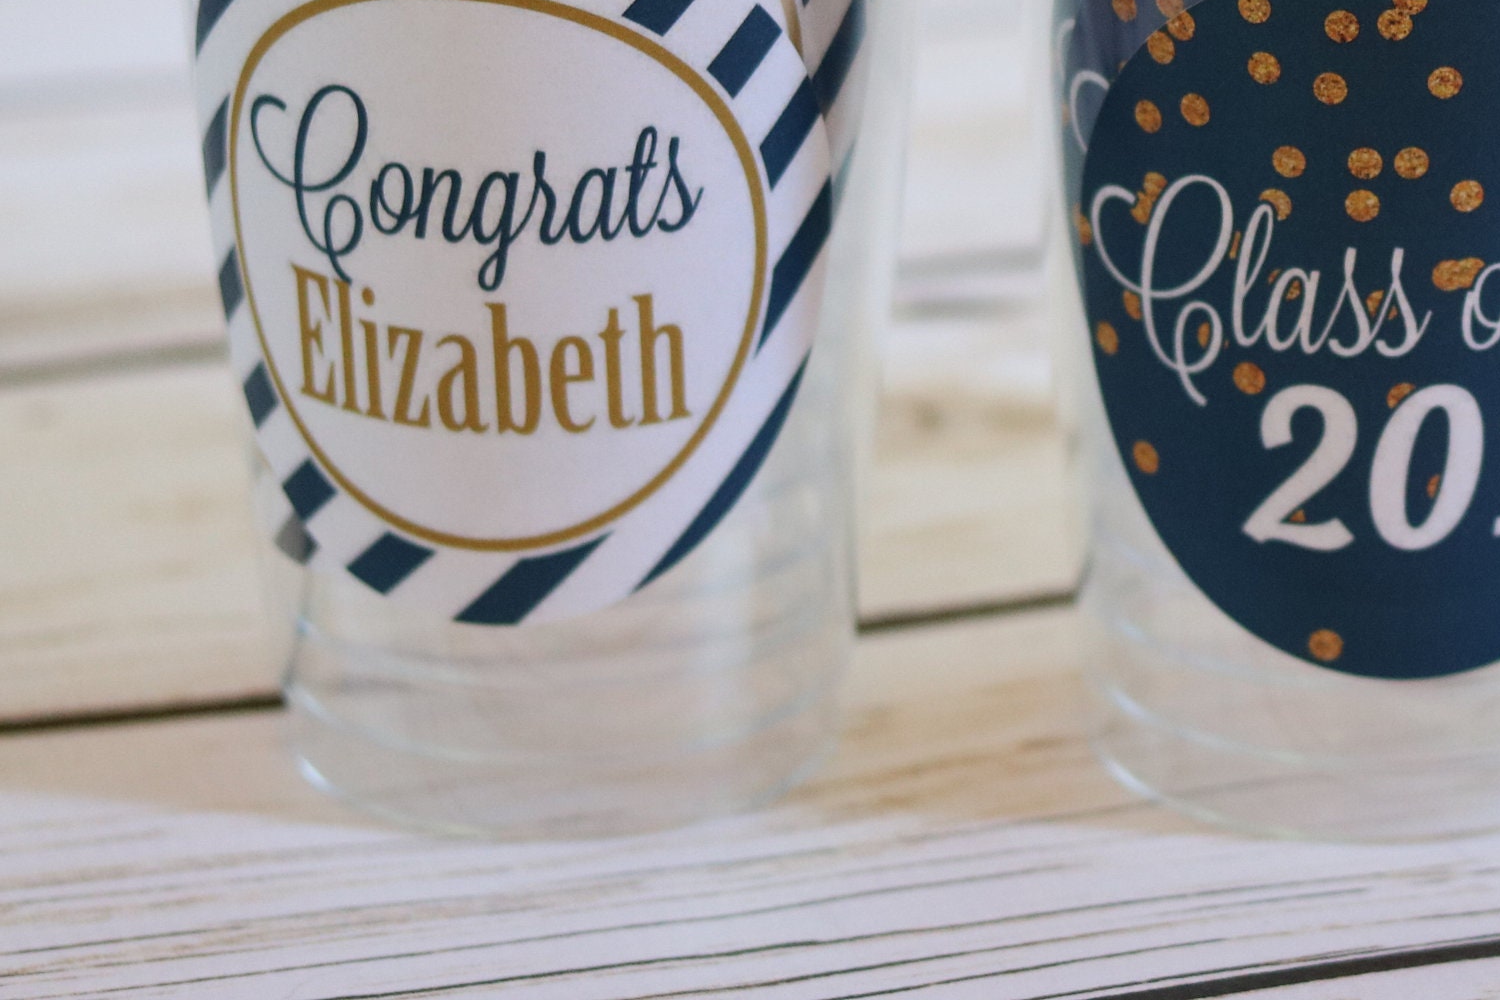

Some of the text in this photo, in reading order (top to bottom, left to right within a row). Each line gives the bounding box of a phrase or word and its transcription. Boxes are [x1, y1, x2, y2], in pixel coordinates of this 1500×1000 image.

[250, 84, 704, 292] Congrats
[1090, 174, 1433, 406] Class
[290, 262, 690, 436] Elizabeth
